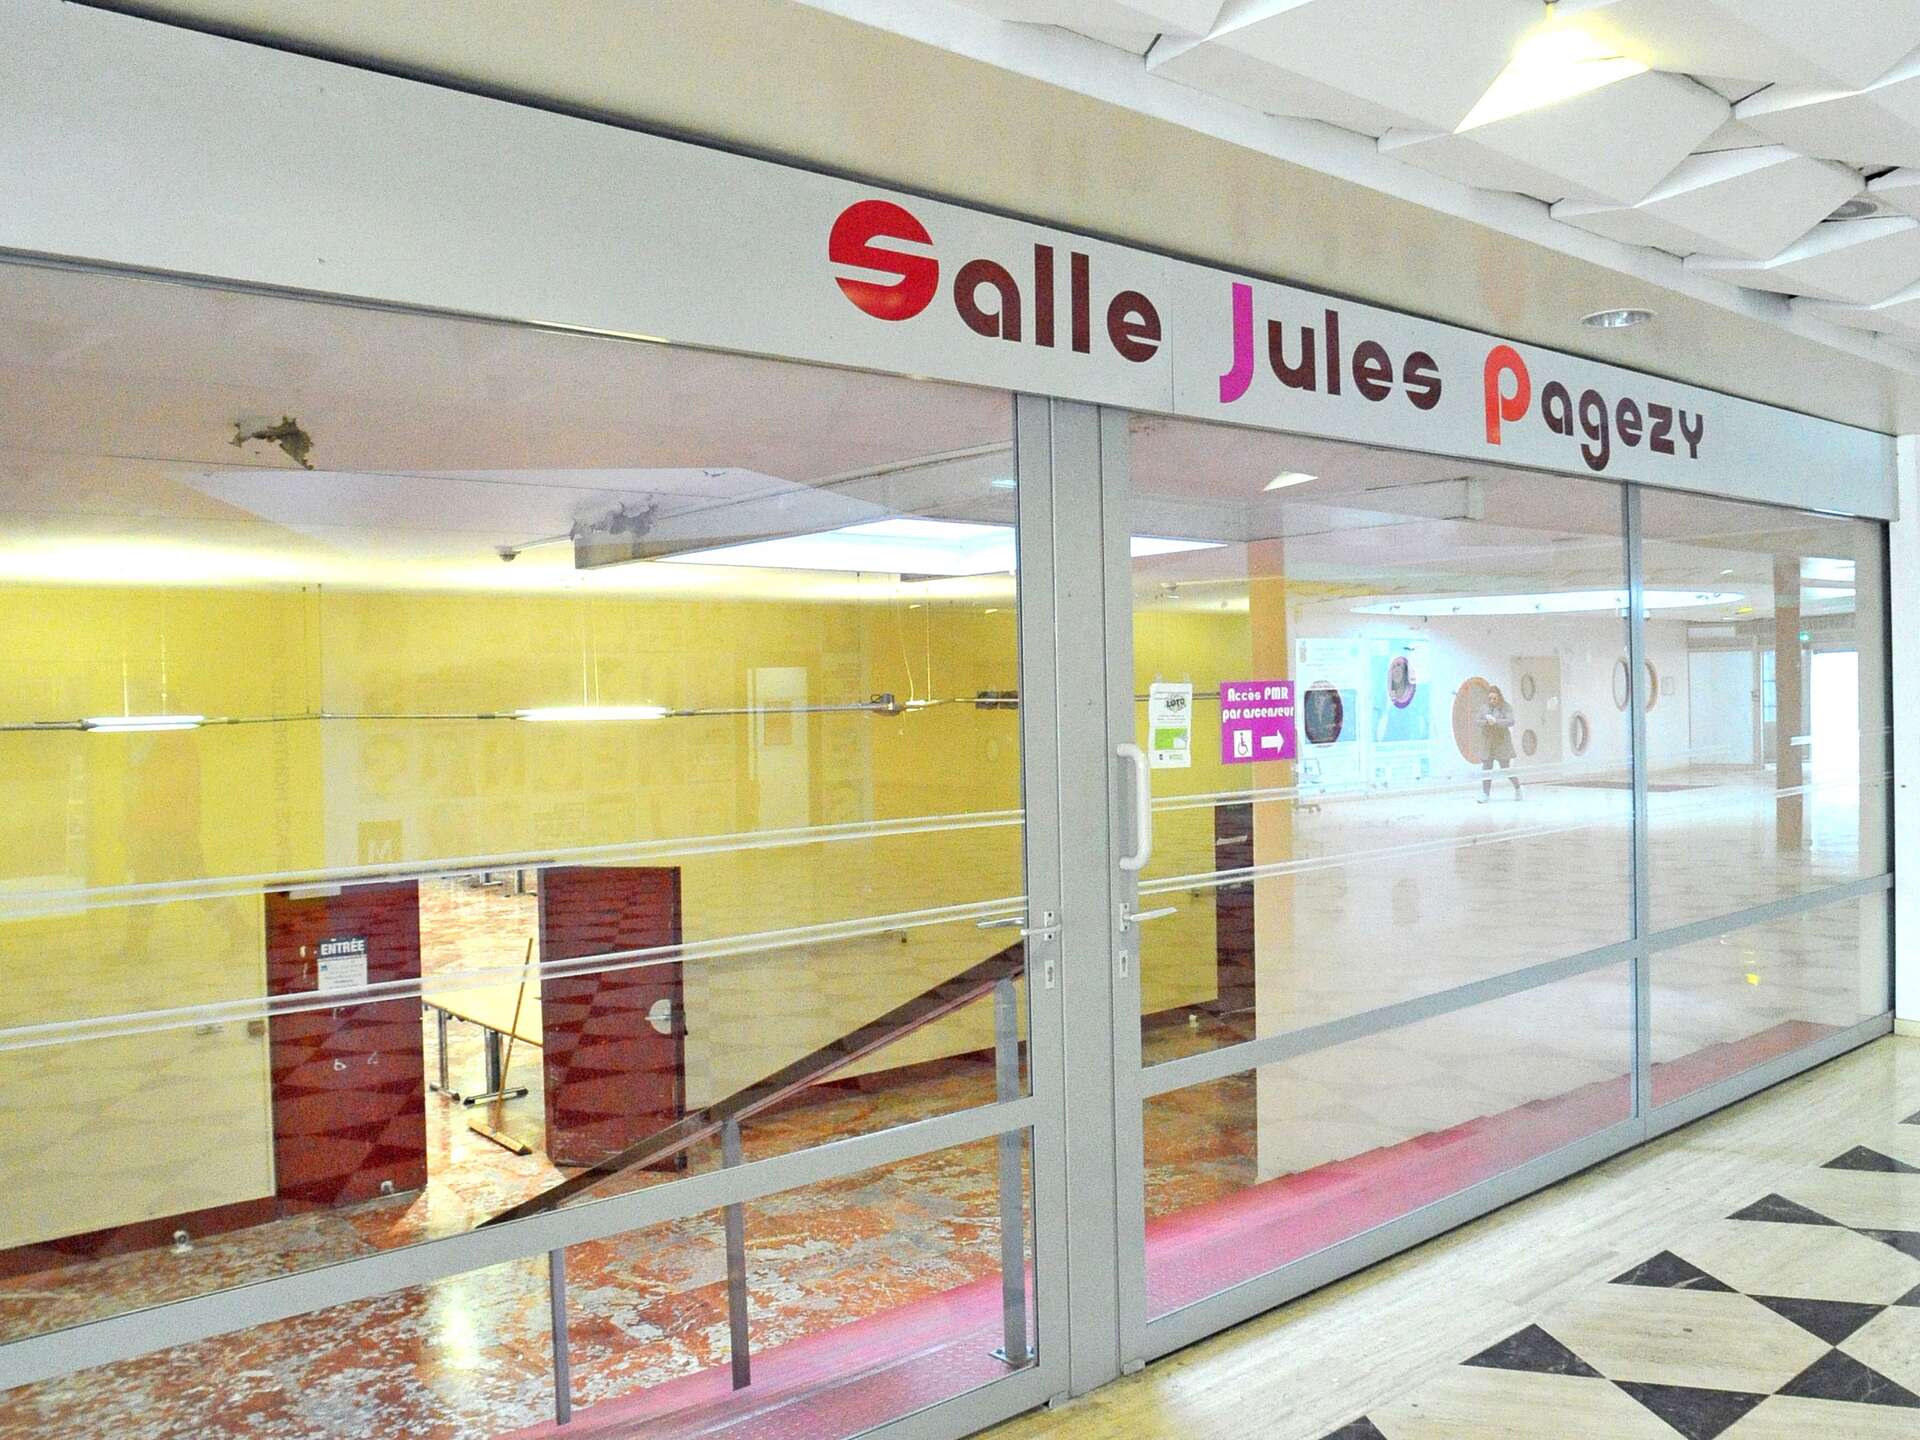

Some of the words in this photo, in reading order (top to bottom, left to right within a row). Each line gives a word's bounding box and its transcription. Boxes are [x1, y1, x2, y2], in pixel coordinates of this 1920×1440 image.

[829, 200, 1162, 362] Salle
[1219, 282, 1442, 410] Jules
[1484, 345, 1704, 471] Pagezy
[1228, 687, 1261, 701] Accès
[1264, 686, 1289, 700] PMR
[1222, 707, 1241, 723] par
[1243, 705, 1295, 719] ascenseur
[321, 938, 365, 956] ENTRÉE
